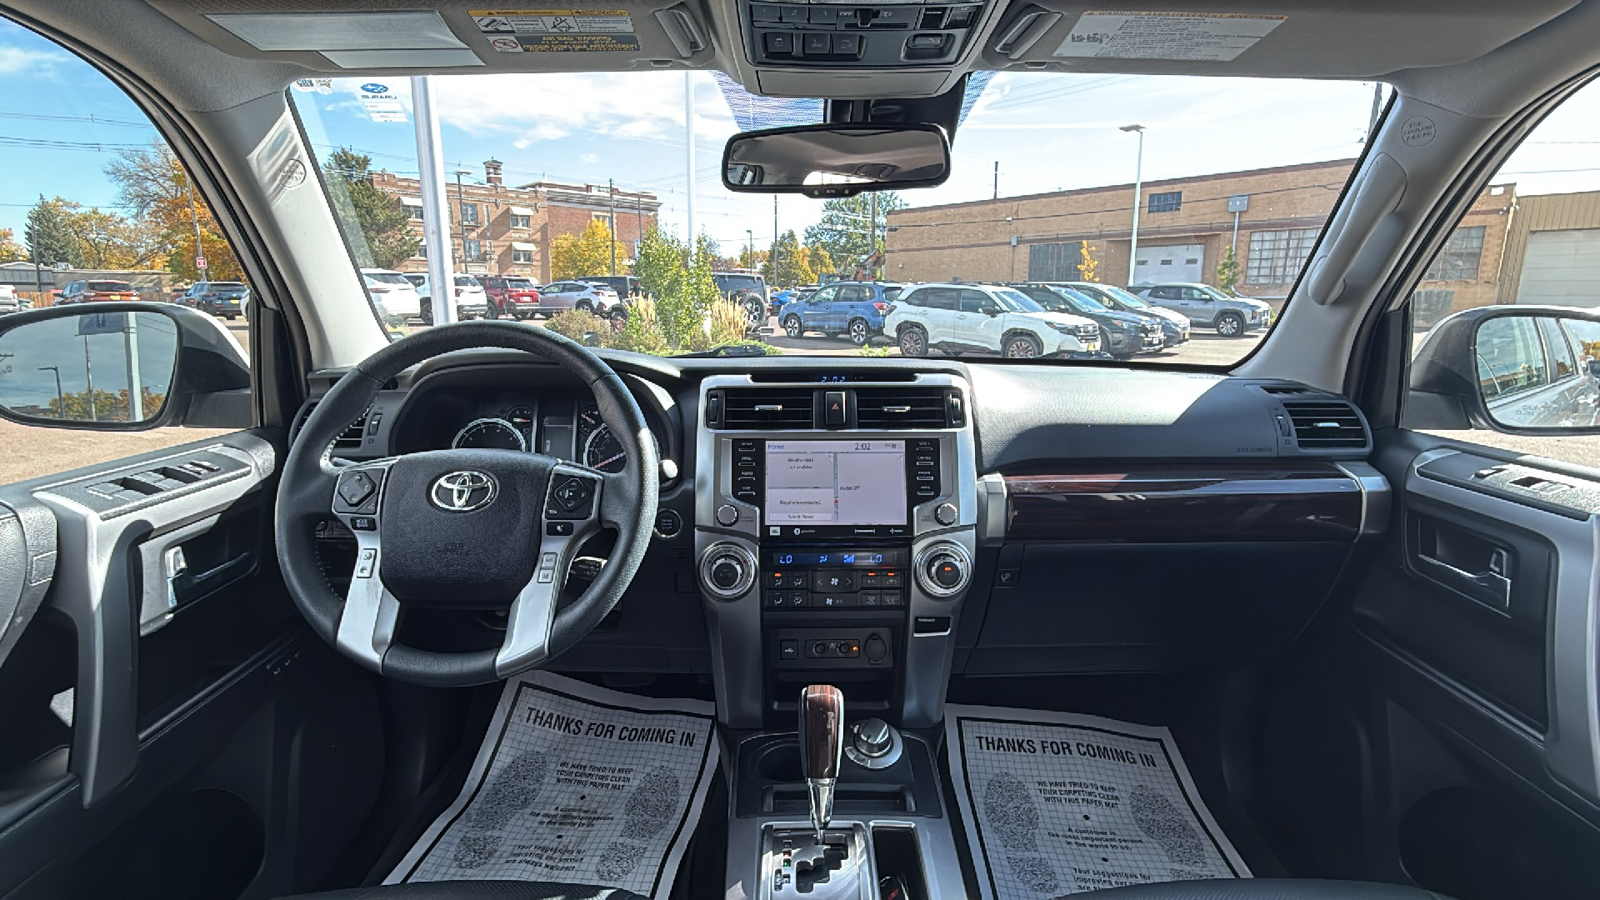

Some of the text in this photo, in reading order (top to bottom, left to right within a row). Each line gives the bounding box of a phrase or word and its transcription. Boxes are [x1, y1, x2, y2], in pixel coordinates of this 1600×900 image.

[854, 442, 871, 451] 2:02
[780, 555, 793, 564] LO
[870, 555, 883, 564] LO
[526, 706, 696, 747] THANKS FOR COMING IN
[976, 736, 1157, 768] THANKS FOR COMING IN
[570, 762, 588, 771] HAVE
[608, 766, 617, 774] TO
[556, 769, 573, 777] YOUR
[574, 771, 609, 781] CARPETING
[573, 779, 588, 787] THIS
[588, 781, 610, 789] PAPER
[1058, 789, 1097, 798] CARPETING
[1098, 793, 1120, 801] CLEAN
[1081, 798, 1103, 807] PAPER
[1071, 867, 1090, 875] Your
[1092, 870, 1138, 879] suggestions
[1073, 875, 1112, 885] improving
